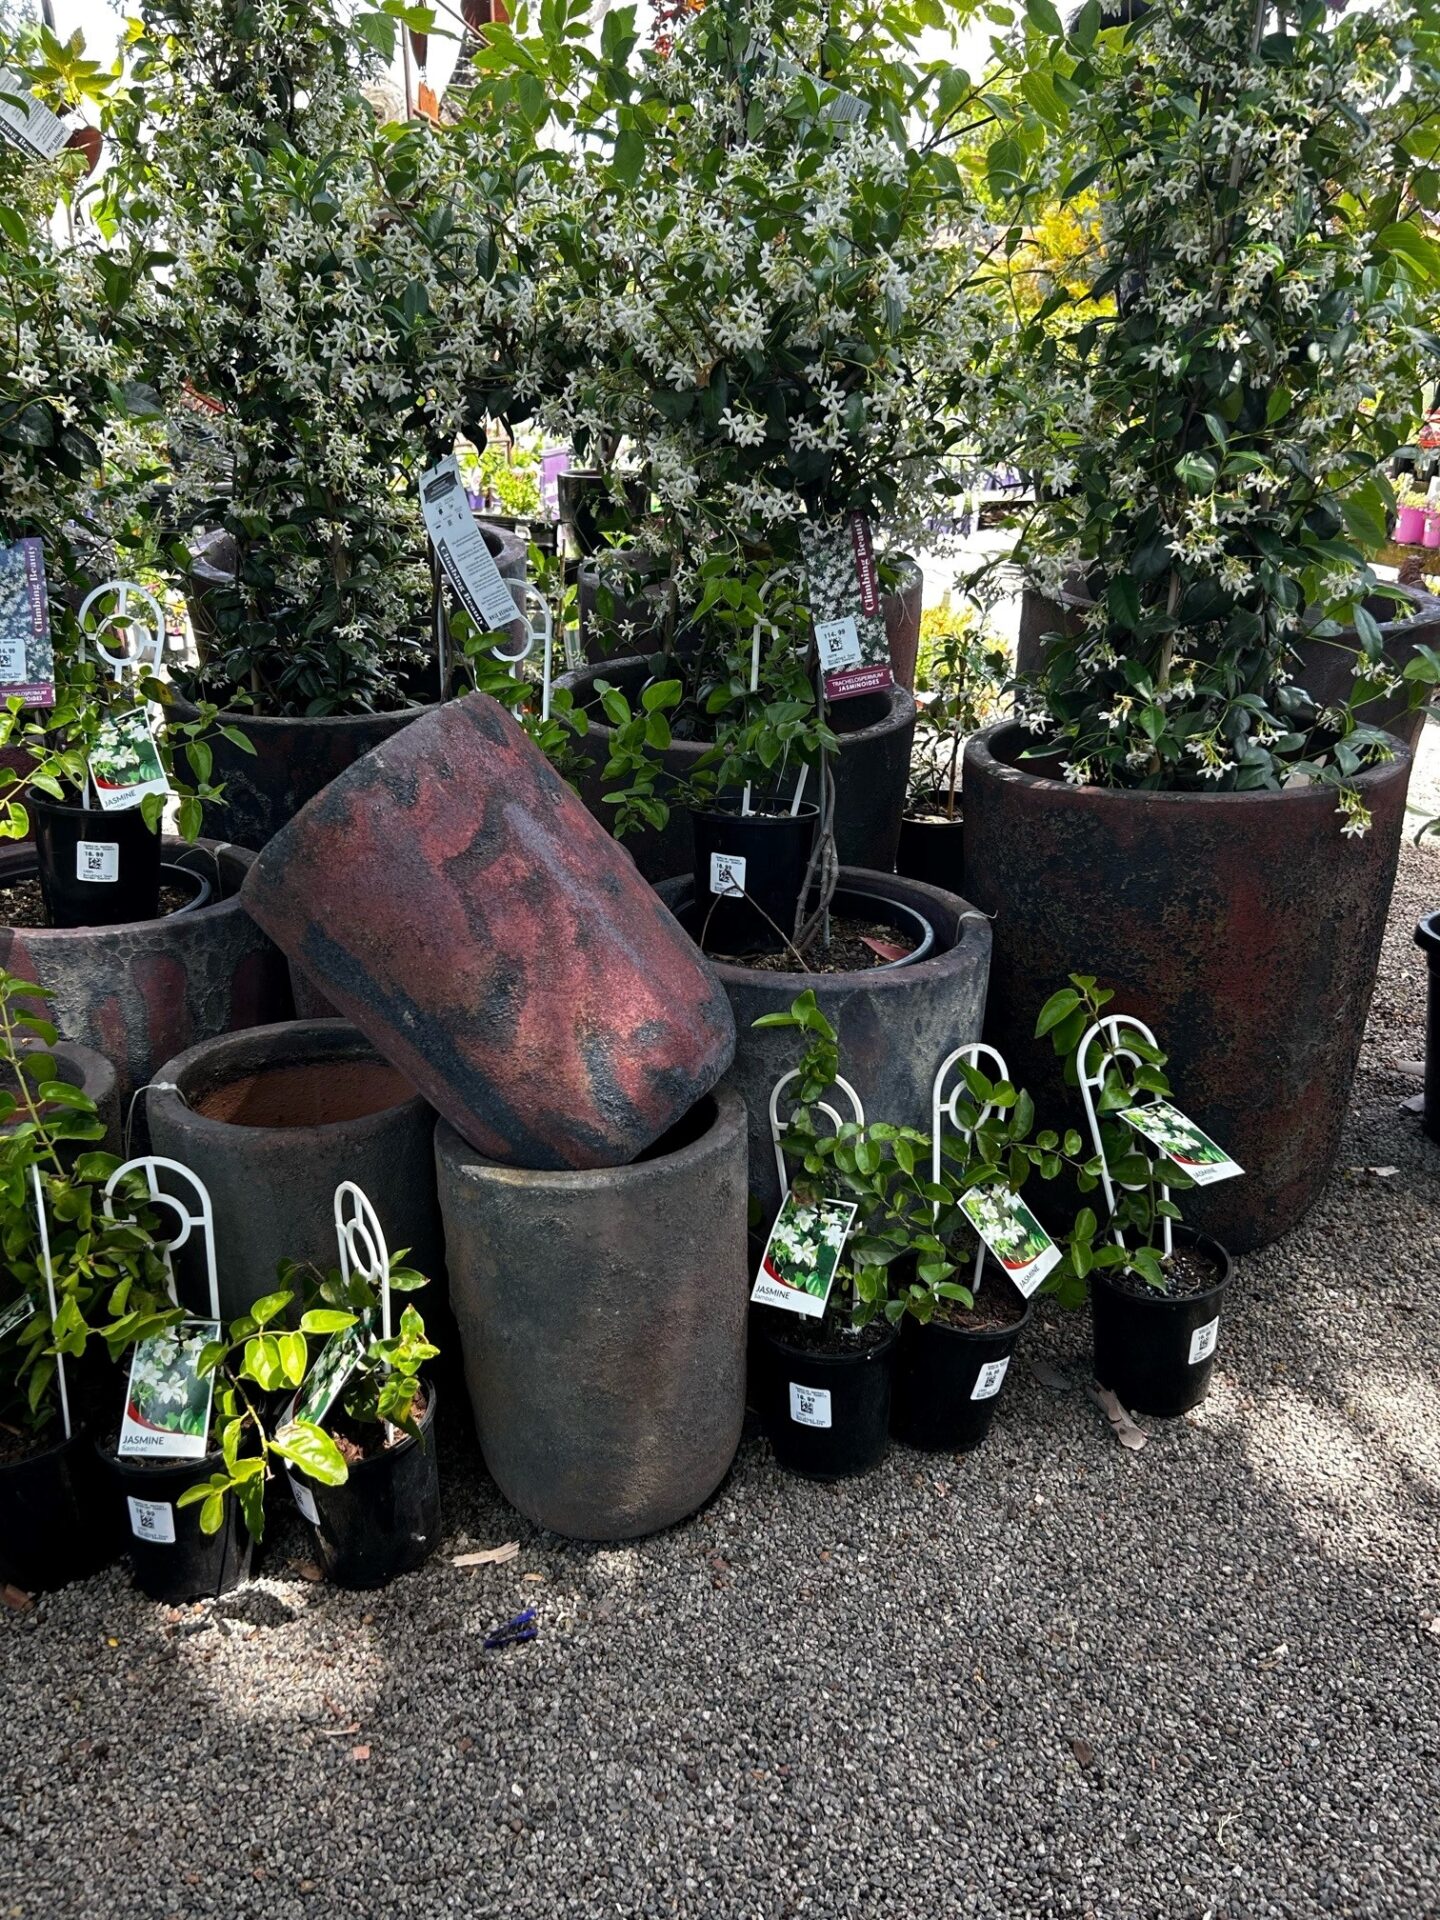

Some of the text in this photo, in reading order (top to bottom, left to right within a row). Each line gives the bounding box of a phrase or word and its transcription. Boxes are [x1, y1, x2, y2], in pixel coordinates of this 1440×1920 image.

[854, 517, 875, 611] Climbing Beauty
[28, 545, 44, 633] Climbing Beauty
[440, 545, 466, 593] Climbing
[463, 590, 485, 626] Beauty
[832, 672, 884, 687] TRACHELOSPERMUM
[838, 678, 880, 692] JASMINOIDES
[104, 790, 136, 807] JASMINE
[1193, 1167, 1217, 1179] JASMINE
[1018, 1263, 1041, 1289] JASMINE
[756, 1285, 791, 1300] JASMINE
[122, 1435, 165, 1446] JASMINE
